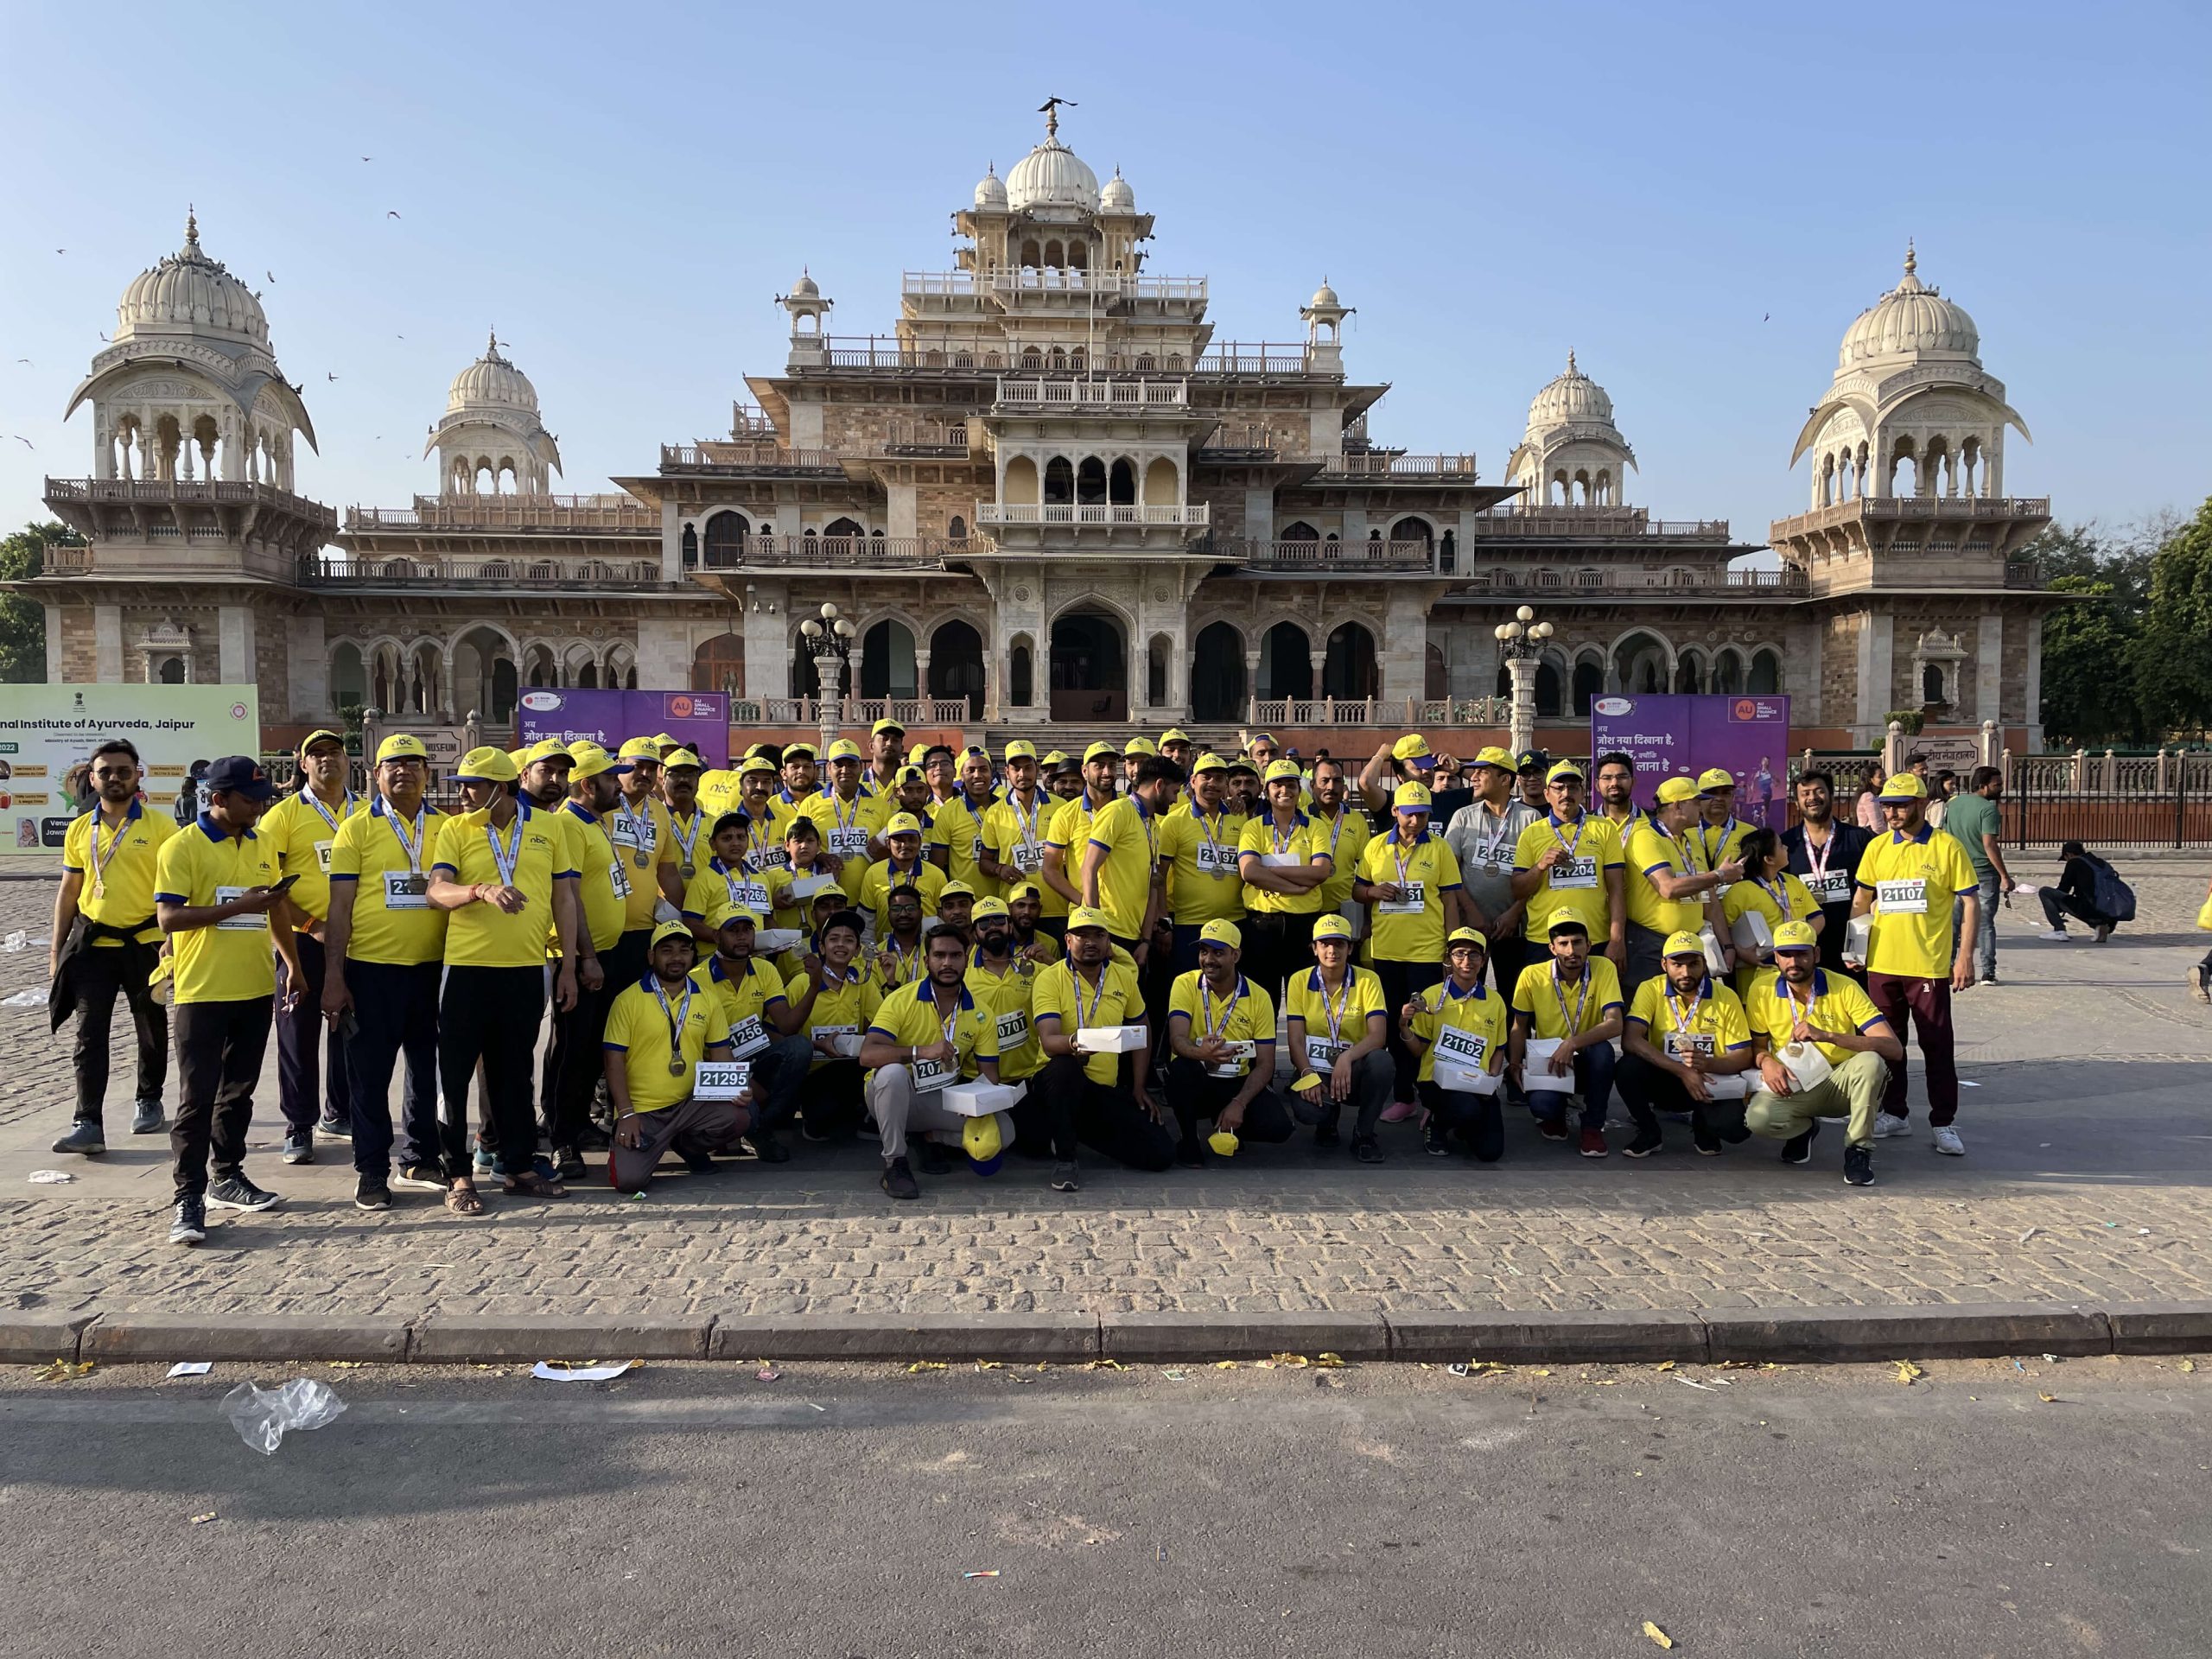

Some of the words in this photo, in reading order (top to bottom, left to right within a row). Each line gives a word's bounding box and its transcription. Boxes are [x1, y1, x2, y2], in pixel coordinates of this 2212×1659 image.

[1738, 705, 1752, 714] AU
[20, 719, 72, 728] Institute
[73, 719, 86, 728] of
[88, 720, 152, 731] Ayurveda,
[155, 720, 195, 731] Jaipur
[524, 730, 543, 741] जोश
[563, 730, 595, 741] दिखाना
[596, 730, 607, 743] है,
[1597, 734, 1615, 745] जोश
[1617, 736, 1633, 745] नया
[1634, 734, 1664, 745] दिखाना
[1665, 733, 1675, 746] है,
[392, 738, 412, 747] nbc
[642, 741, 658, 752] nbc
[1636, 761, 1660, 772] लाना
[1662, 758, 1670, 772] है
[709, 782, 732, 794] nbc
[1886, 780, 1902, 790] nbc
[620, 821, 652, 837] 205
[530, 836, 546, 844] nbc
[833, 835, 868, 846] 2202
[753, 852, 786, 866] 2168
[1480, 847, 1515, 862] 2123
[1921, 863, 1936, 872] nbc
[1807, 879, 1847, 892] 2124
[1884, 887, 1923, 901] 21107
[728, 901, 744, 911] nbc
[980, 900, 997, 910] nbc
[1075, 910, 1093, 918] nbc
[1555, 909, 1573, 918] nbc
[664, 920, 683, 930] nbc
[1322, 919, 1339, 928] nbc
[1779, 929, 1797, 938] nbc
[693, 1012, 706, 1020] nbc
[1484, 1017, 1496, 1026] nbc
[998, 1019, 1025, 1037] 0701
[729, 1024, 763, 1047] 1256
[1444, 1035, 1483, 1058] 21192
[702, 1072, 747, 1085] 21295
